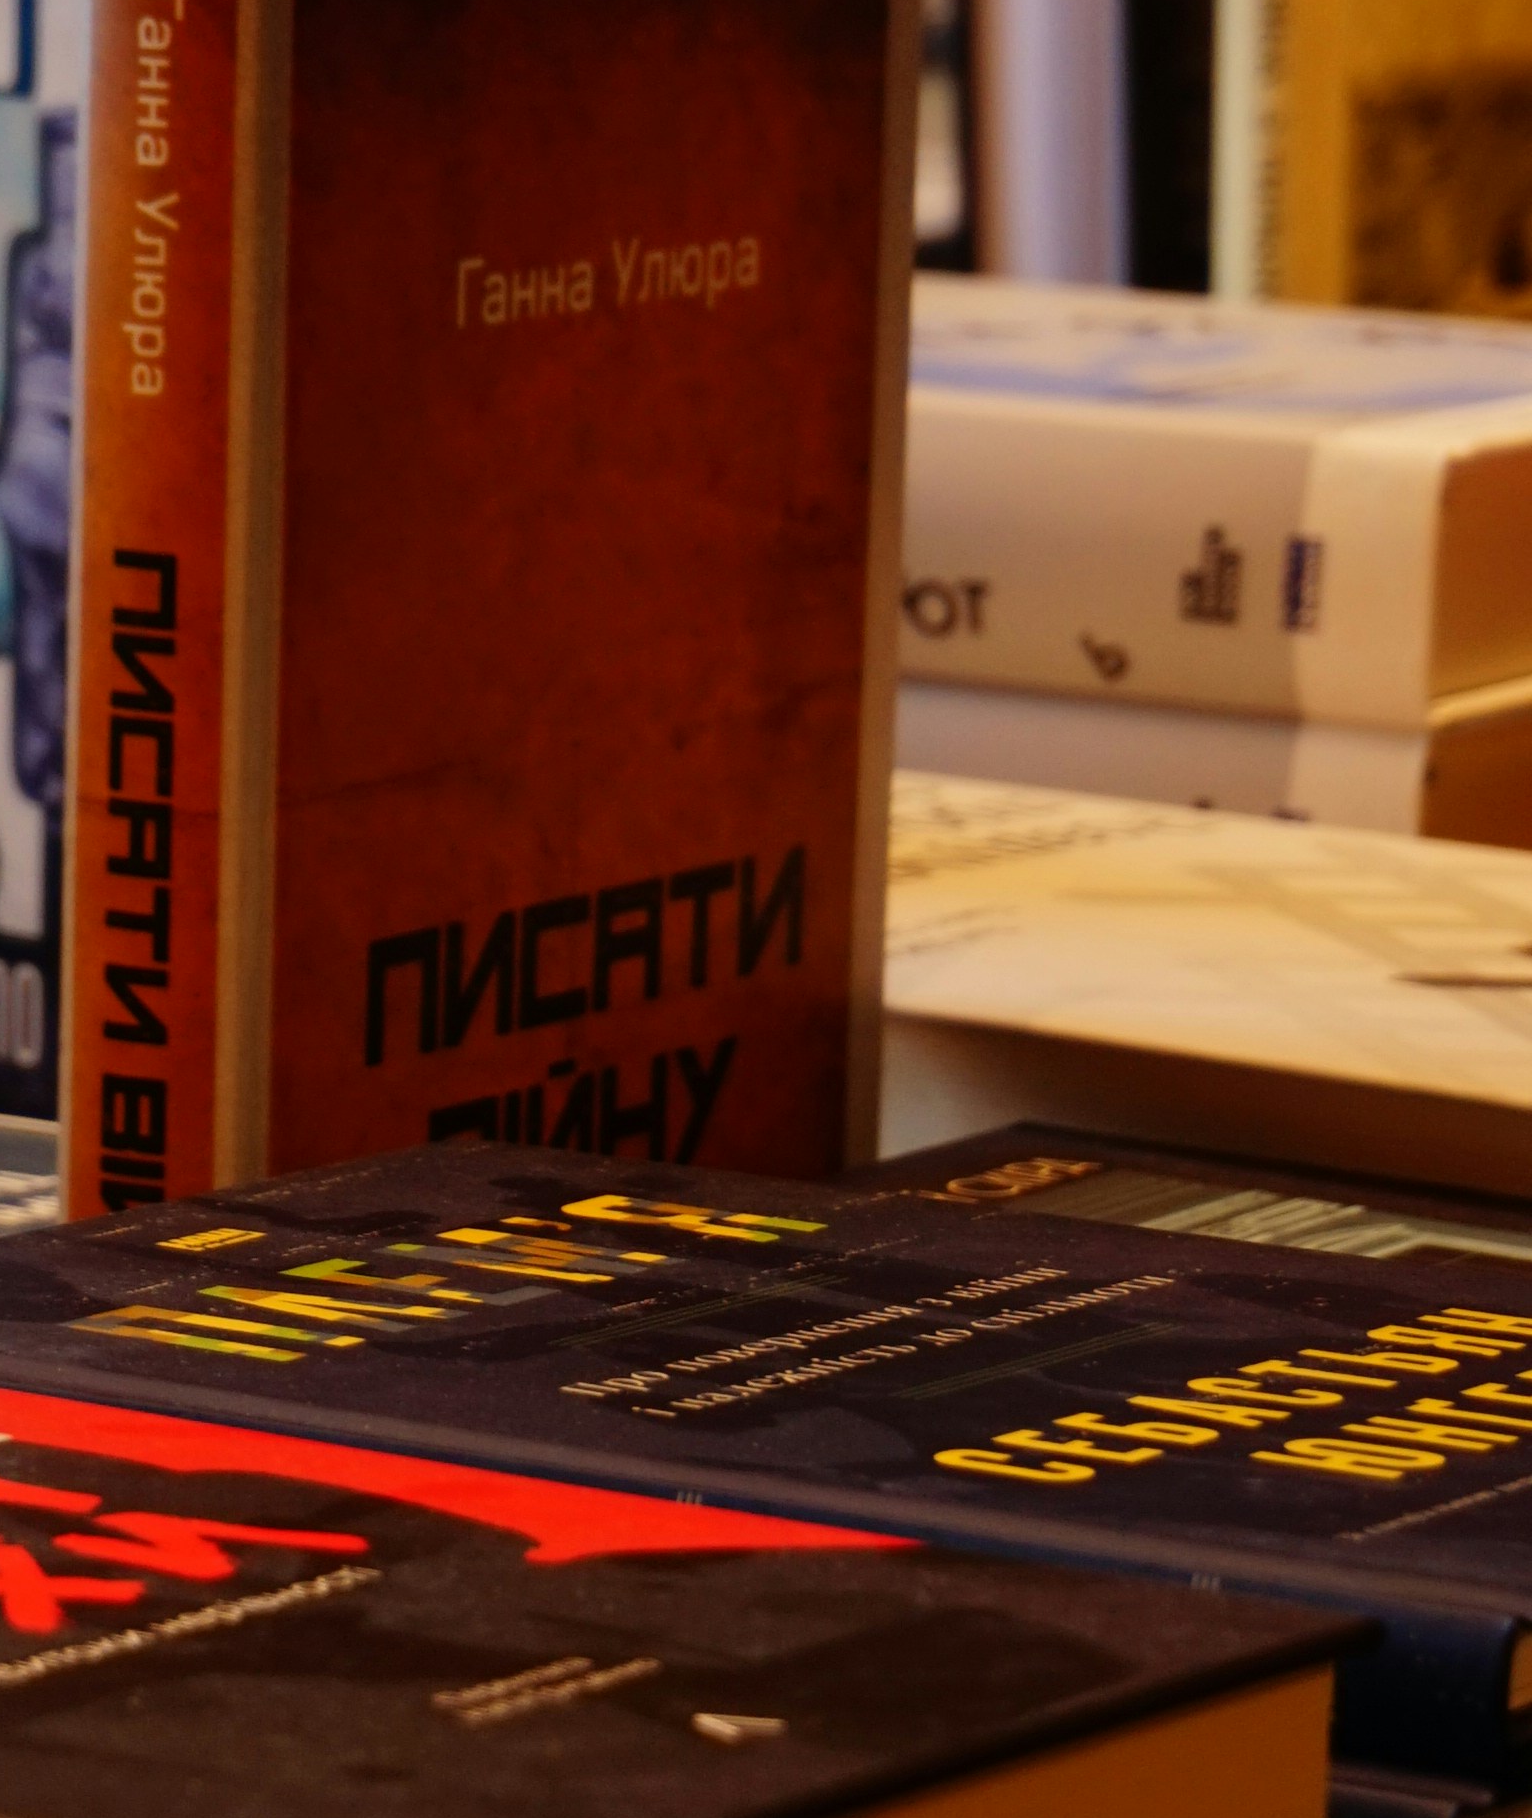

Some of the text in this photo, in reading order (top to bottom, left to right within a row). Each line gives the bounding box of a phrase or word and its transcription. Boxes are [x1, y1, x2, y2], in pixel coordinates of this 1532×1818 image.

[120, 191, 181, 396] Улюра
[455, 235, 760, 329] Ганна Улюра
[102, 548, 179, 1043] ПИСАТИ
[363, 841, 806, 1068] ПИСАТИ
[557, 1364, 670, 1400] Про
[932, 1304, 1532, 1486] СЕБАСТЬЯН
